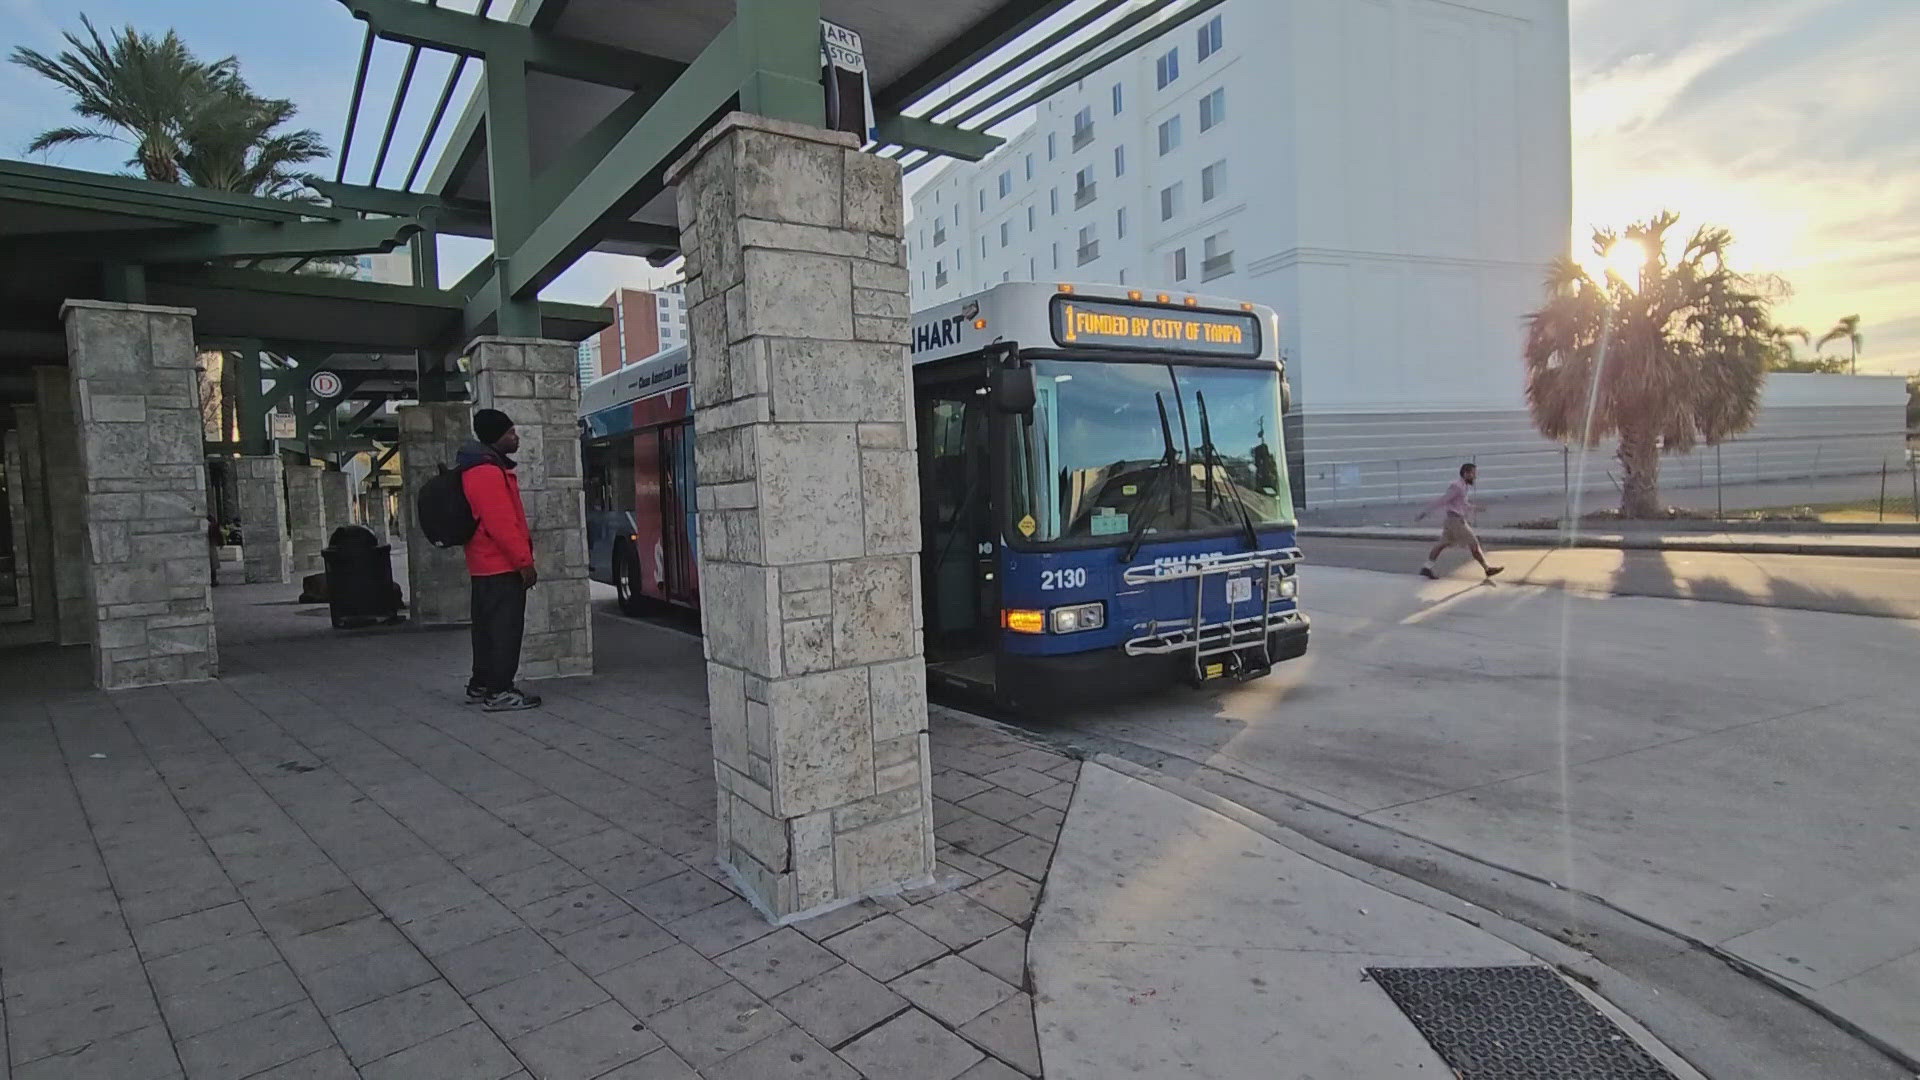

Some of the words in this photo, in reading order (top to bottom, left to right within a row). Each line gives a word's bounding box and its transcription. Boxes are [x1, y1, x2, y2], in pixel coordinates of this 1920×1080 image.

[830, 46, 861, 66] STOP
[1065, 304, 1077, 341] 1
[1077, 312, 1129, 336] FUNDED
[1131, 316, 1150, 337] BY
[1152, 318, 1182, 340] CITY
[1185, 321, 1200, 341] OF
[1203, 322, 1243, 344] TAMPA
[319, 377, 333, 391] D
[1040, 567, 1086, 590] 2130
